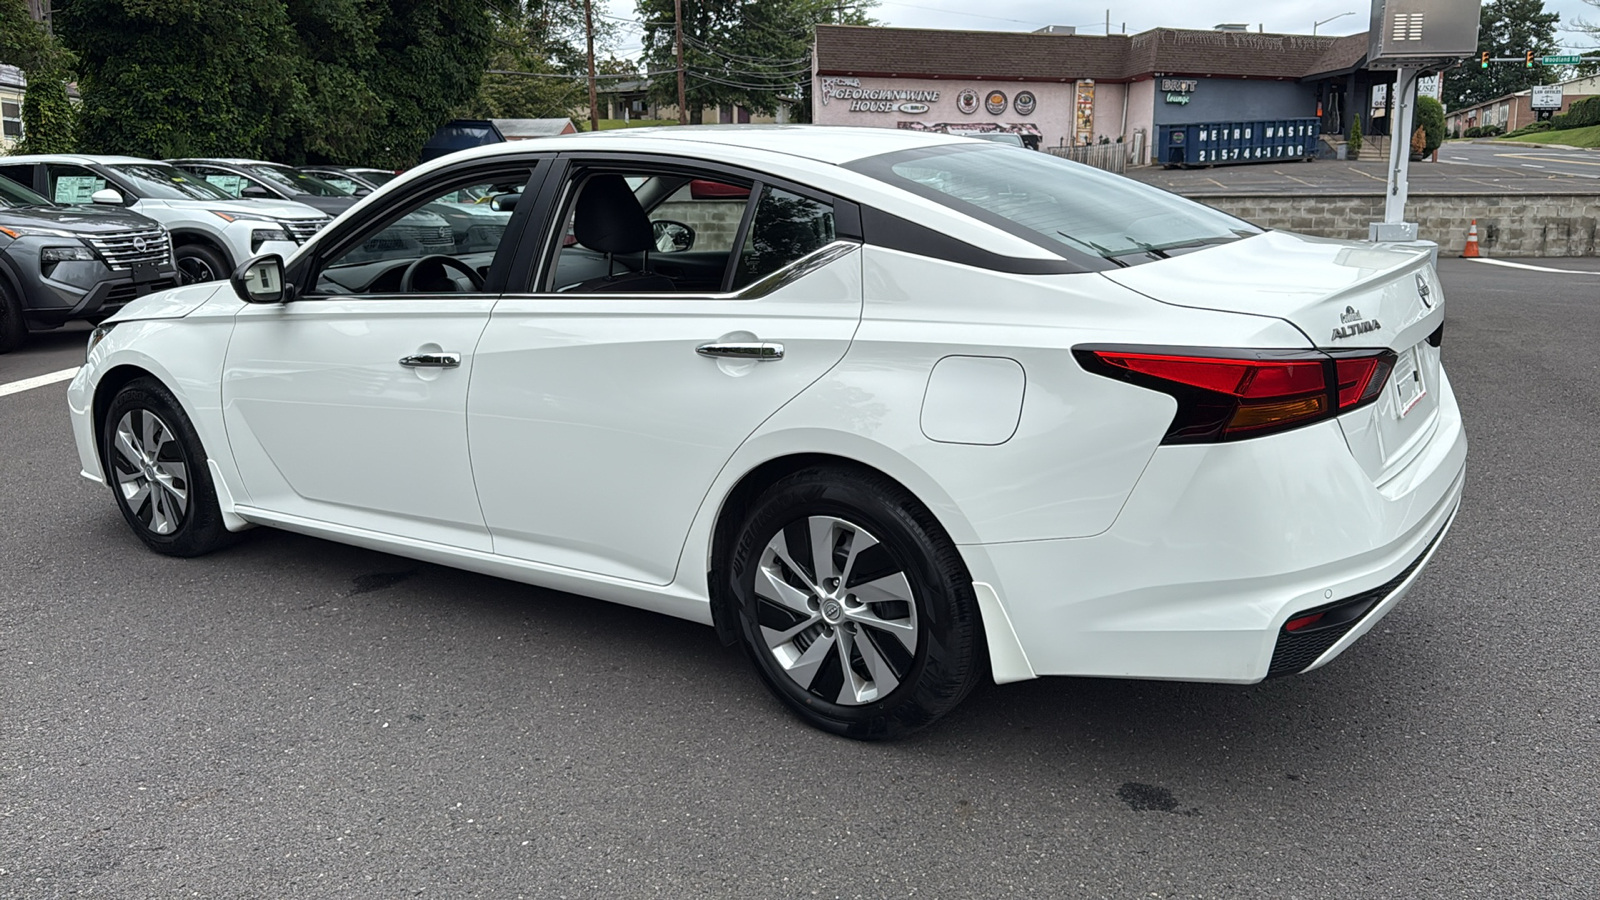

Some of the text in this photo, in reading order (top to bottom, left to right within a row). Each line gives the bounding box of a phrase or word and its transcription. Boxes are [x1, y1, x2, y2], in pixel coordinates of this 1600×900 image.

[1161, 79, 1198, 92] BRUT
[834, 88, 941, 102] GEORGIAN WINE
[1166, 92, 1190, 105] lounge
[849, 100, 893, 112] HOUSE
[1200, 125, 1313, 141] METRO WASTE
[1200, 145, 1303, 161] 215-744-1700
[1331, 319, 1381, 341] ALTIMA
